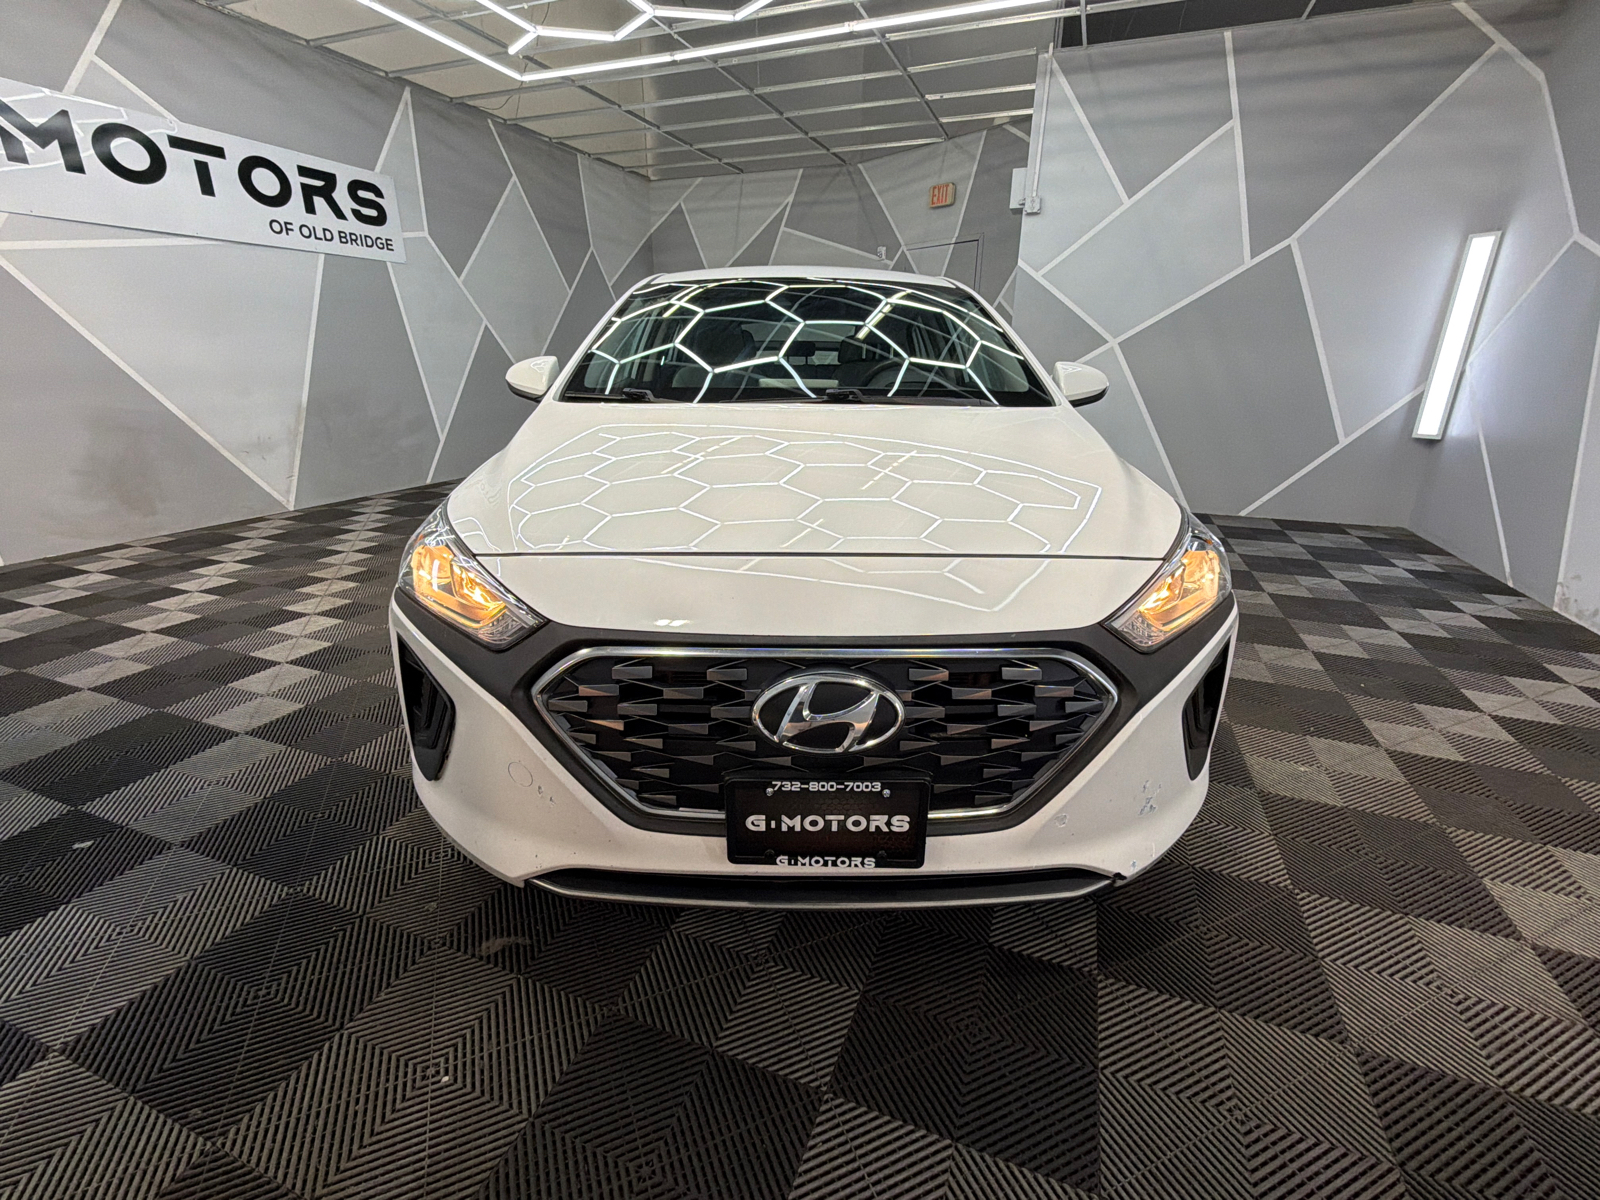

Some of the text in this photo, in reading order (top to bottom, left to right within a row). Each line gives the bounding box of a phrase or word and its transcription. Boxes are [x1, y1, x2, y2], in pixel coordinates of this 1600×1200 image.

[0, 99, 388, 227] MOTORS
[931, 183, 950, 206] EXIT
[268, 218, 395, 252] OF OLD BRIDGE
[772, 781, 882, 792] 732-800-7003
